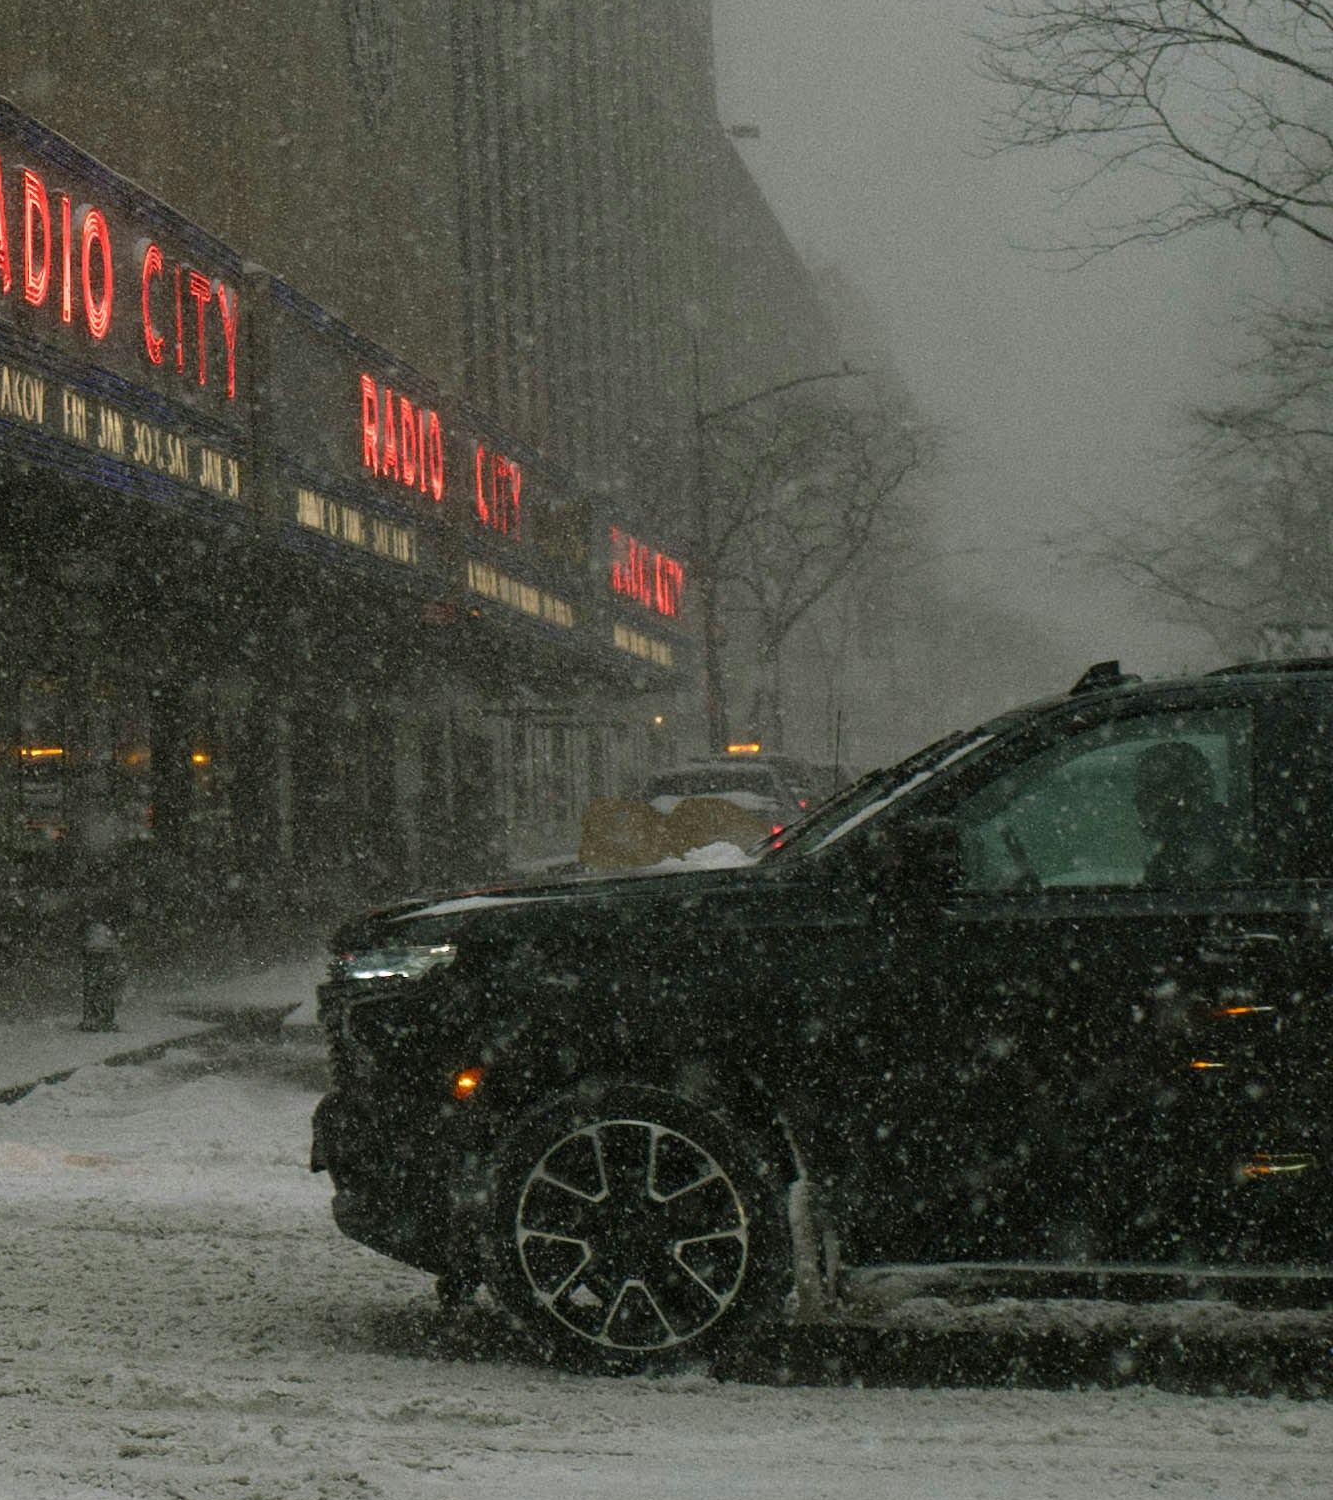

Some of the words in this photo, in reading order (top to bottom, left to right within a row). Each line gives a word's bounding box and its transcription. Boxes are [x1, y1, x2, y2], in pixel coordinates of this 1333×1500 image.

[141, 242, 240, 399] CITY
[61, 387, 88, 443] FRI
[97, 404, 125, 456] JAN
[360, 372, 445, 502] RADIO
[475, 444, 522, 541] CITY
